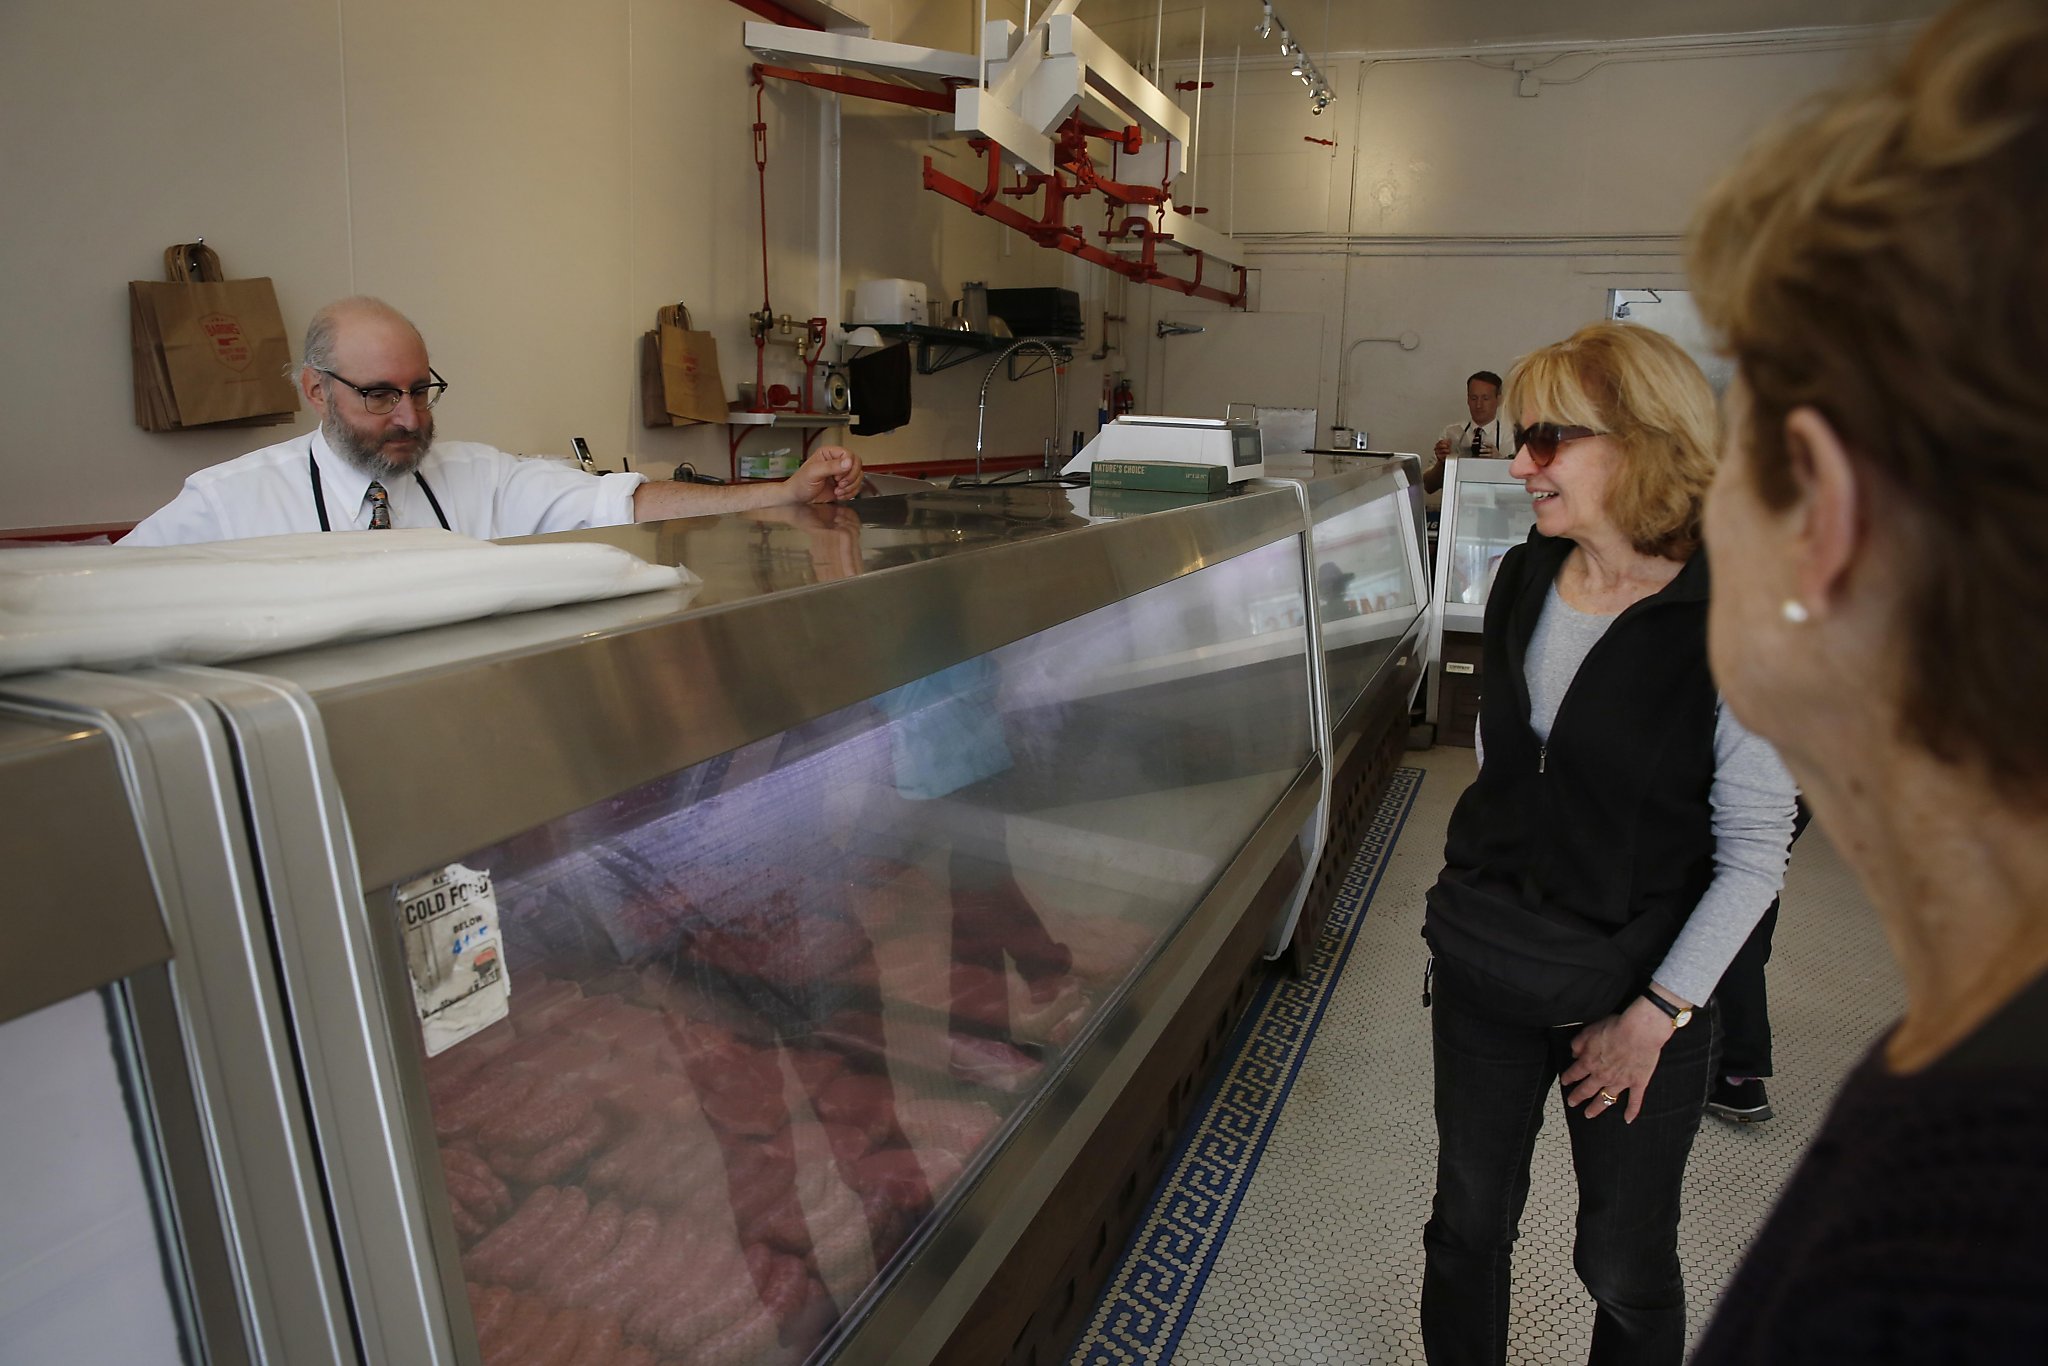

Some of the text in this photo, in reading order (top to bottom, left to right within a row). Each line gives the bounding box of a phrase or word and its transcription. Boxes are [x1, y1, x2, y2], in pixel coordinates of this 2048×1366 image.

[1094, 463, 1145, 475] NATURE'S CHOICE
[405, 881, 488, 925] COLD FOD
[453, 915, 482, 933] BELOW
